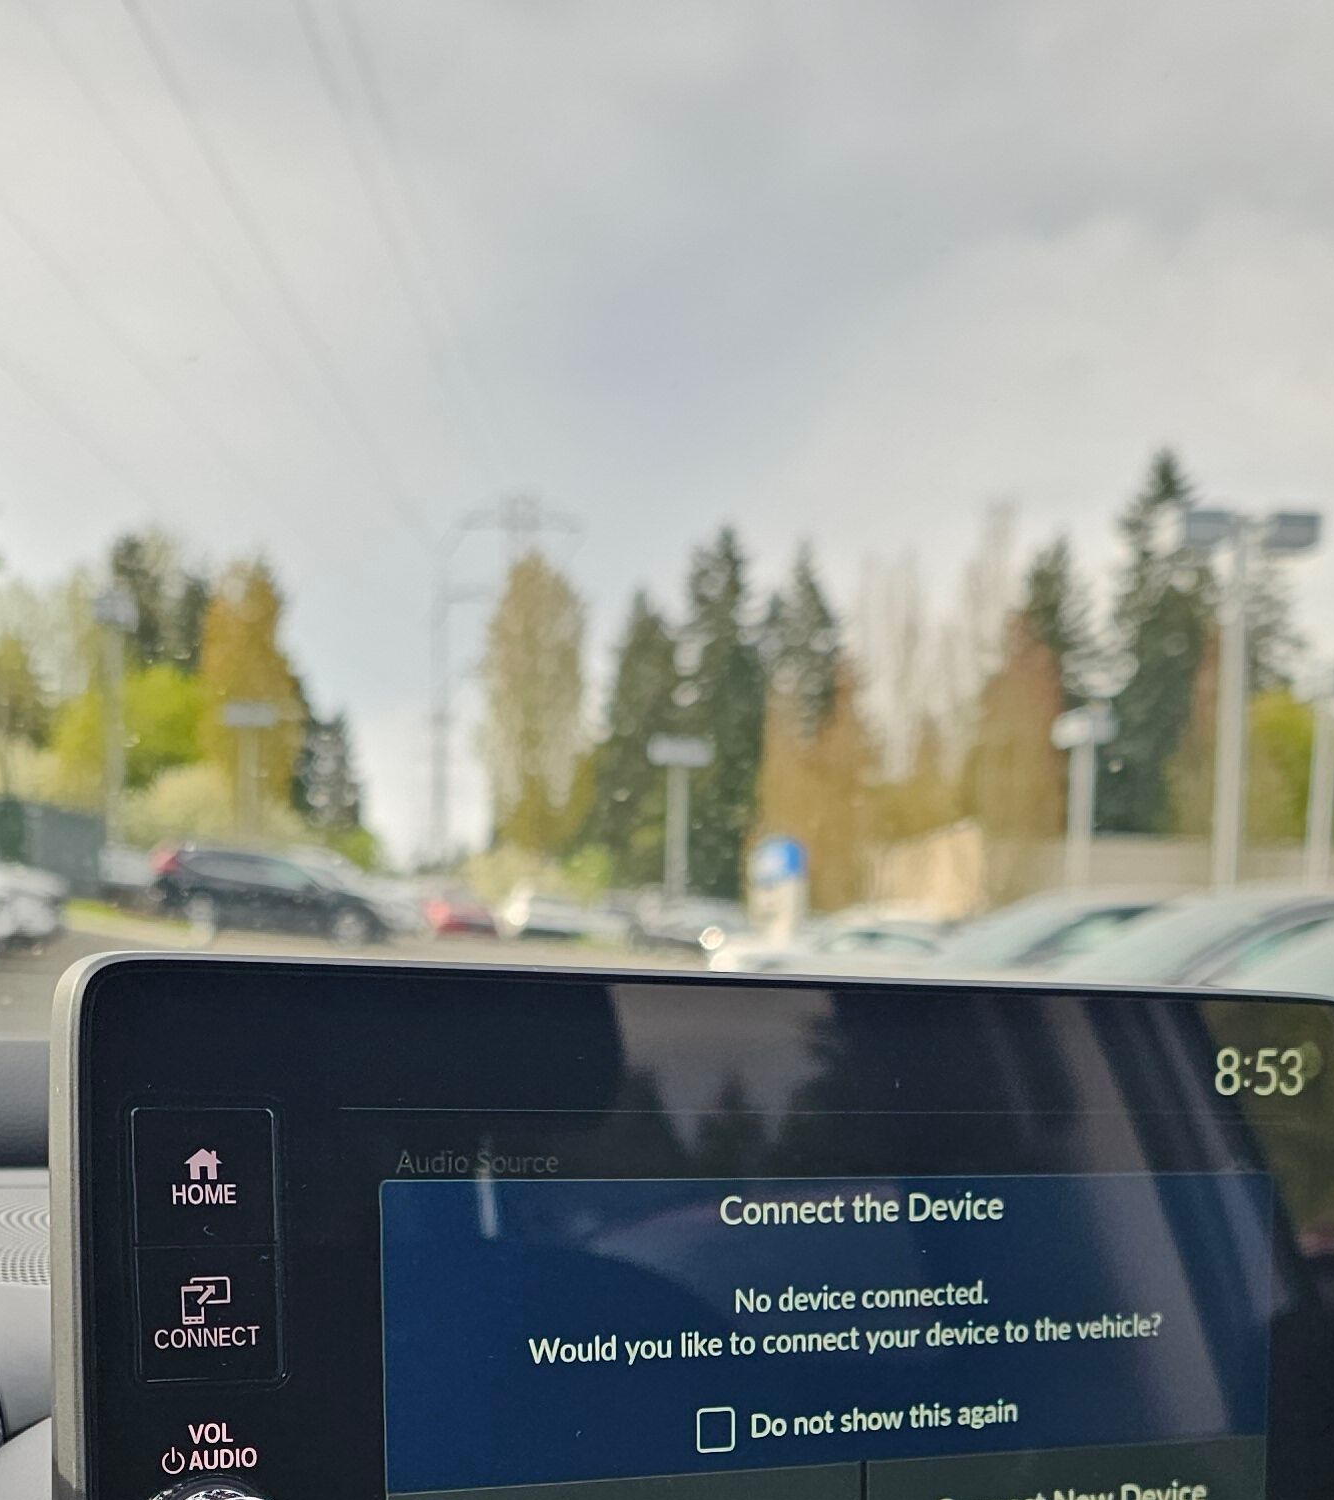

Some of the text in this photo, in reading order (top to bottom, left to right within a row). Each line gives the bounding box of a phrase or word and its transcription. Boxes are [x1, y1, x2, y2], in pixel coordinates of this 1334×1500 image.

[1215, 1047, 1304, 1096] 8:53
[396, 1150, 559, 1175] Audio Source
[171, 1183, 237, 1205] HOME
[719, 1191, 1004, 1226] Connect the Device
[734, 1279, 989, 1314] No device connected.
[154, 1325, 260, 1349] CONNECT
[528, 1312, 1162, 1366] Would you like to connect your device to the vehicle?
[188, 1422, 234, 1445] VOL
[750, 1398, 1019, 1439] Do not show this again
[189, 1447, 258, 1471] AUDIO
